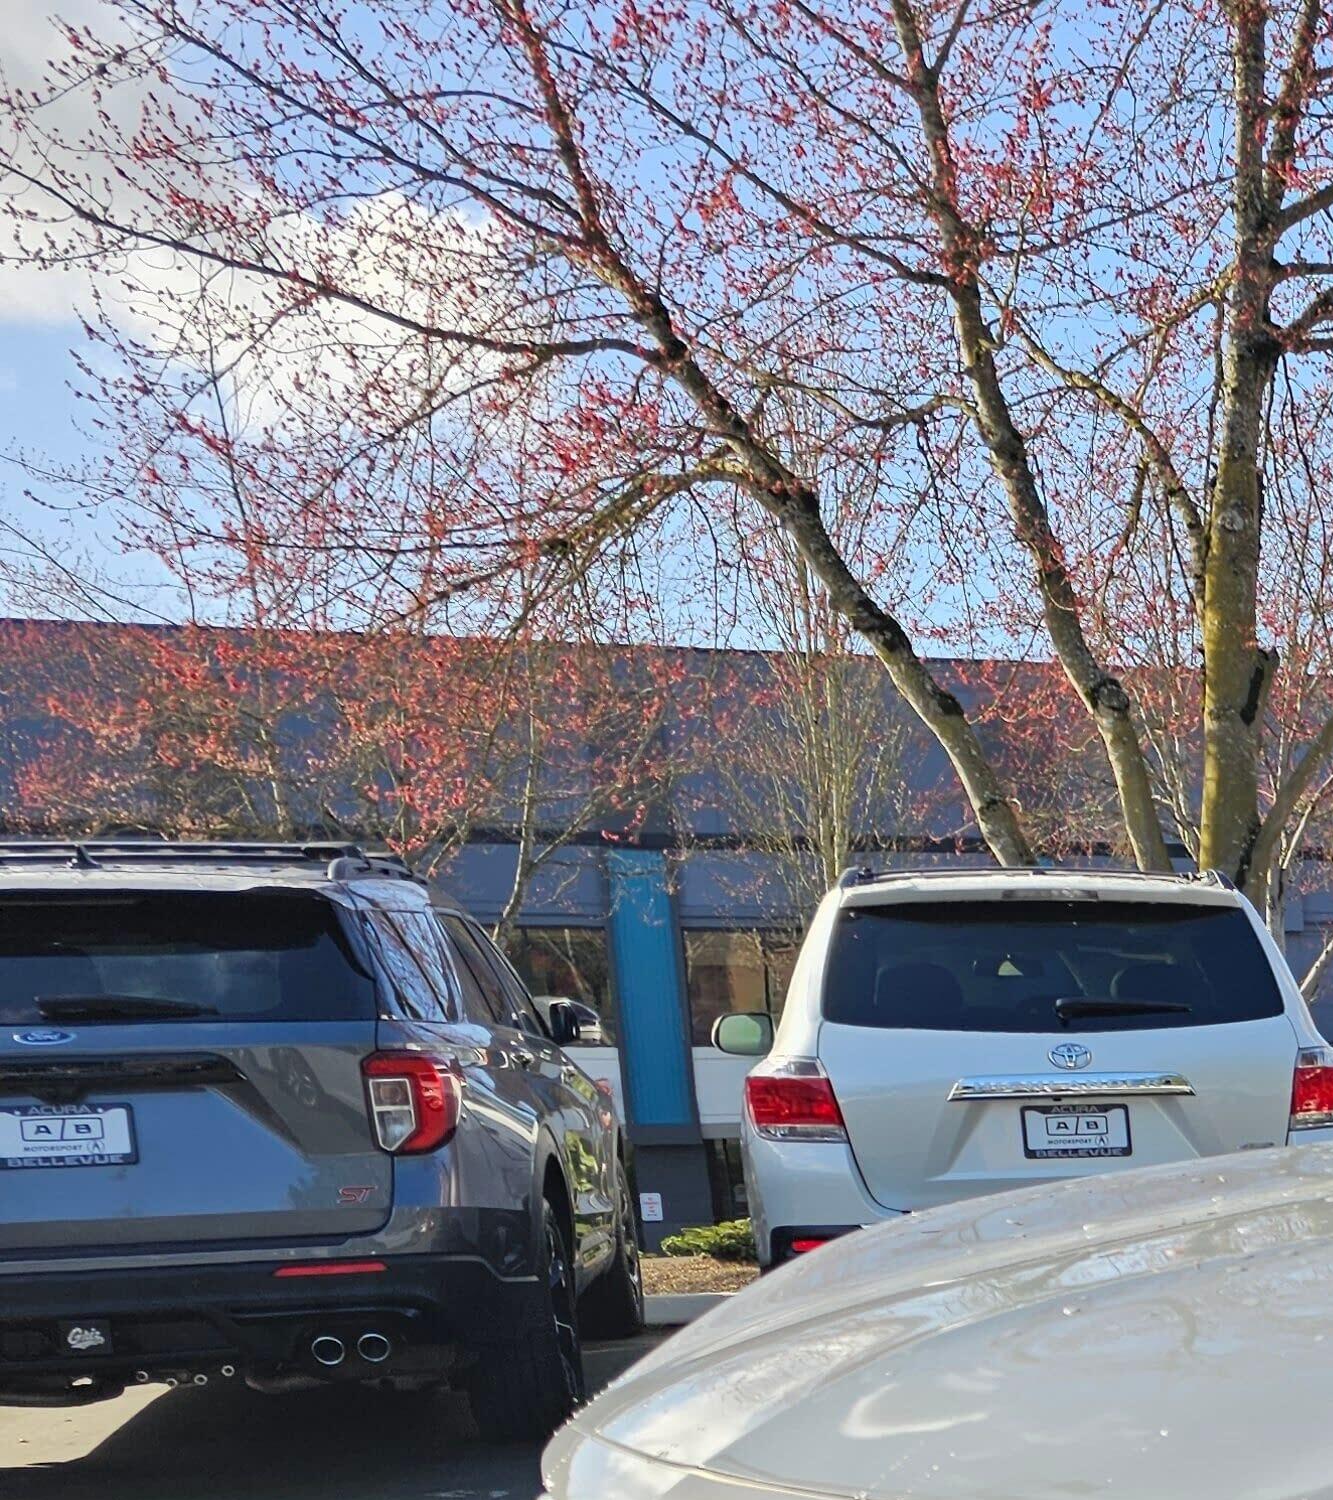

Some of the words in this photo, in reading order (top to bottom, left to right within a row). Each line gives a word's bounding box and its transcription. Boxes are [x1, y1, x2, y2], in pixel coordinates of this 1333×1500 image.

[27, 1105, 92, 1115] ACURA
[1051, 1105, 1100, 1114] ACURA
[23, 1144, 83, 1153] MOTORSPORT
[1035, 1147, 1122, 1158] BELLEVUE
[7, 1154, 124, 1168] BELLEVUE
[336, 1185, 378, 1204] ST
